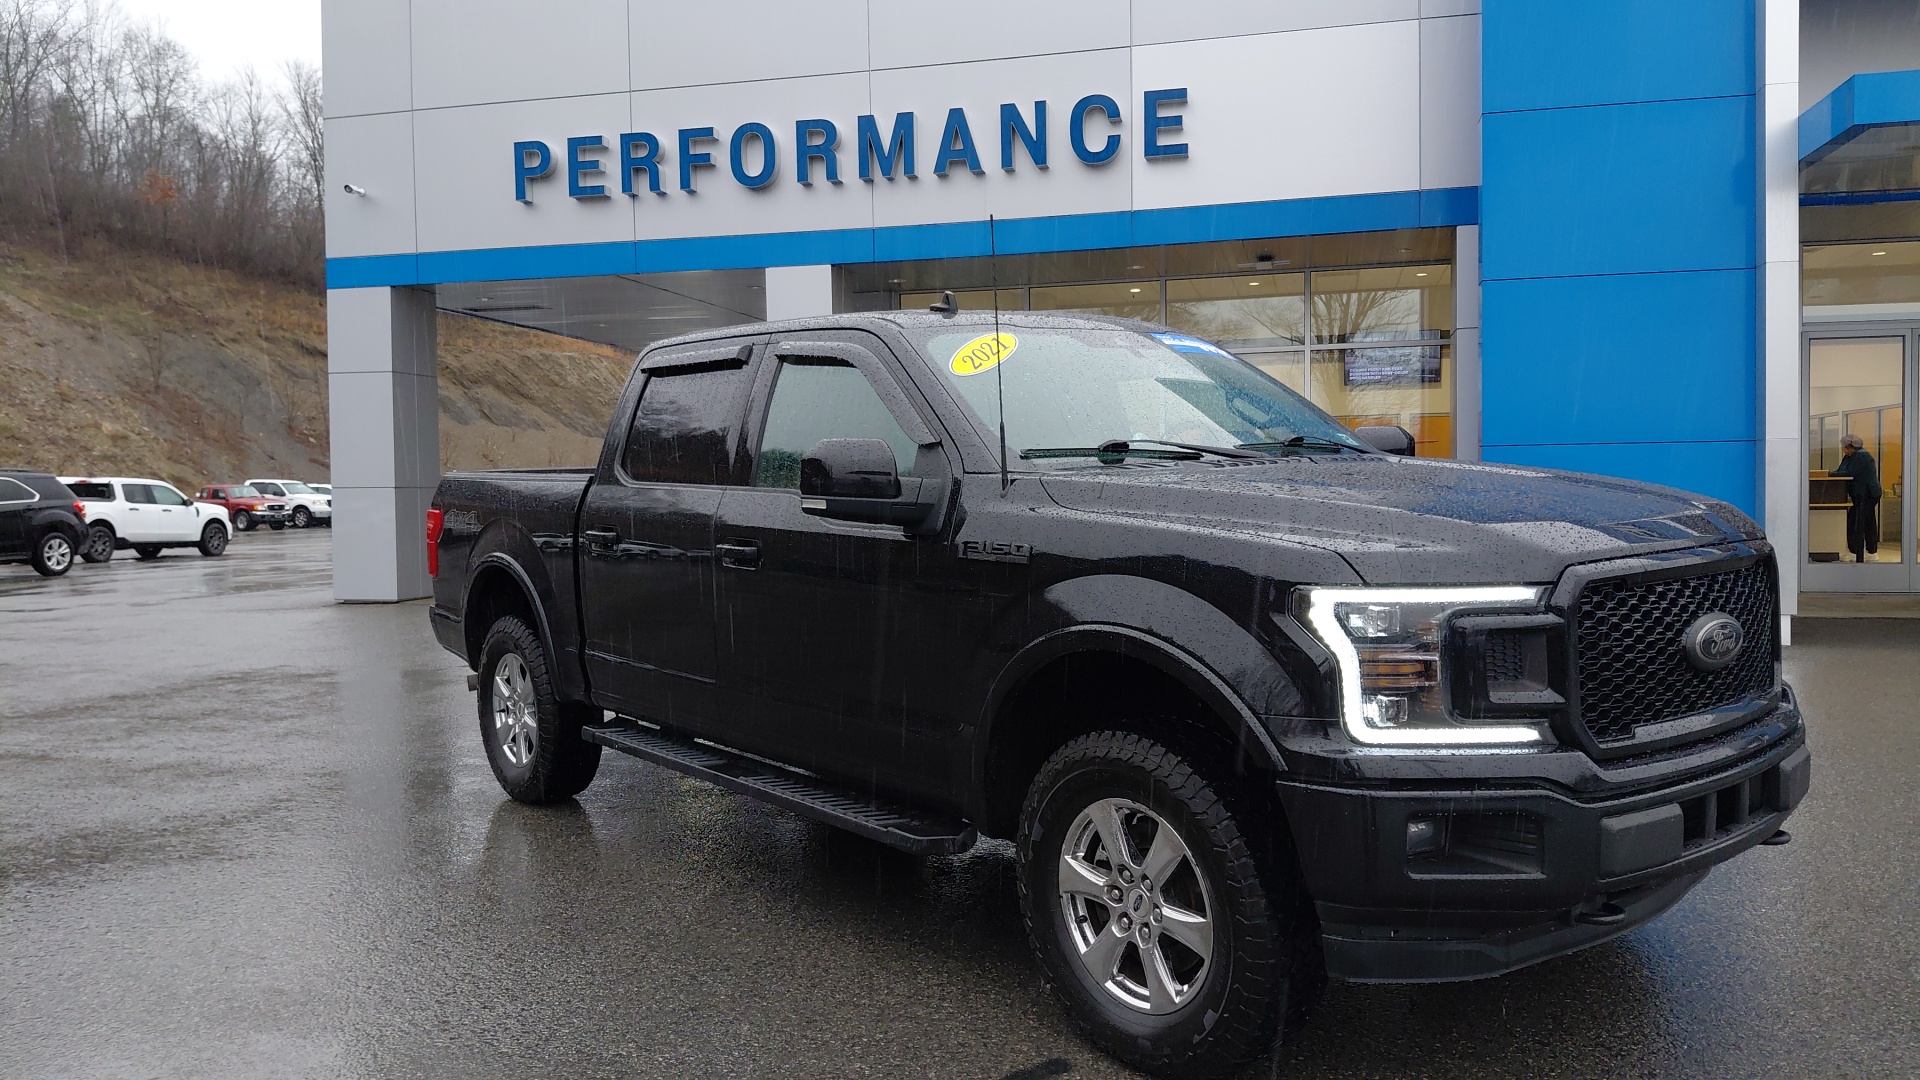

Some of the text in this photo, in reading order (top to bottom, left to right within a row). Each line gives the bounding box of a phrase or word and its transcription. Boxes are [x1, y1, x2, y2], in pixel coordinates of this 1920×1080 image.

[513, 87, 1189, 204] PERFORMANCE
[962, 337, 1011, 370] 2021
[1711, 629, 1736, 655] Ford
